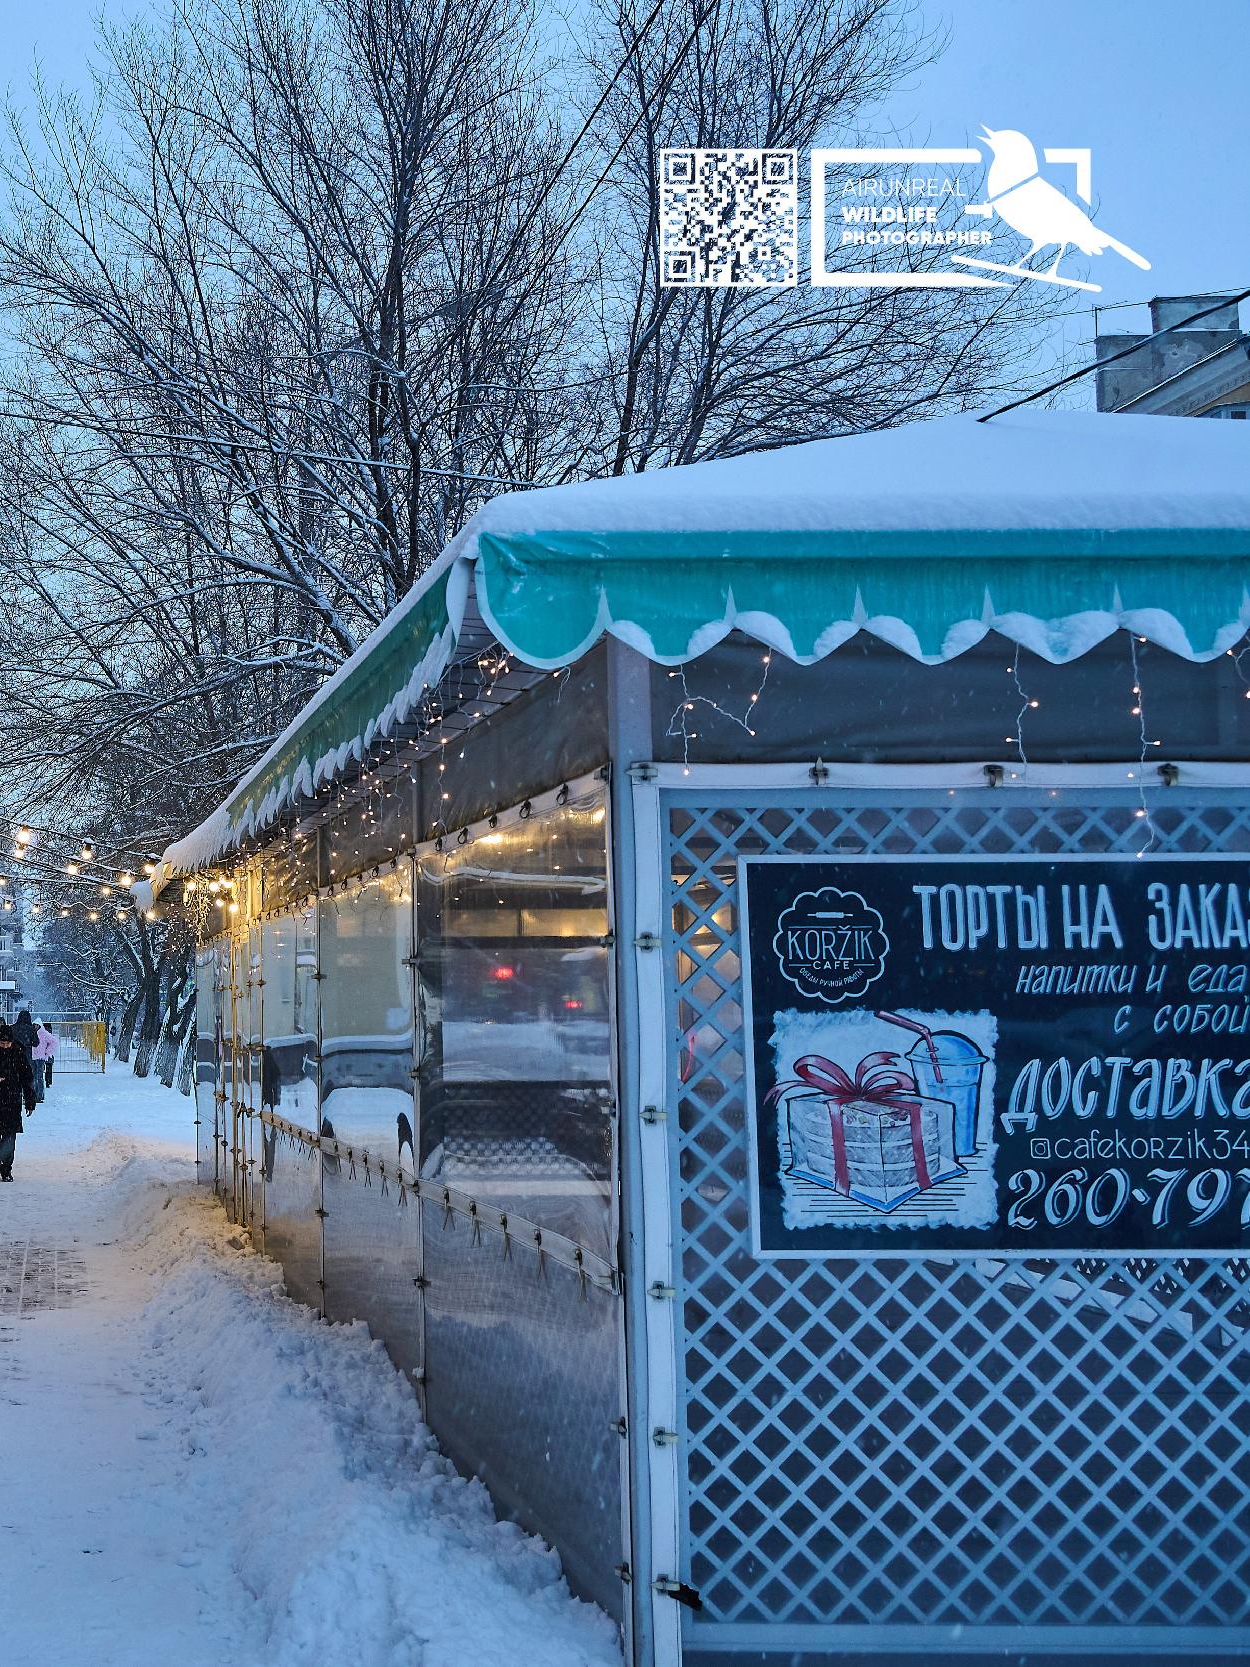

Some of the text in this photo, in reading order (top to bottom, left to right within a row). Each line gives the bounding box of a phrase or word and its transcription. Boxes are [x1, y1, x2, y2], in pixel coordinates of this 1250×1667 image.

[912, 882, 1250, 951] ТОРТЫ НА ЗАКА
[812, 961, 850, 970] CAFE
[1015, 964, 1248, 995] напитки и еда
